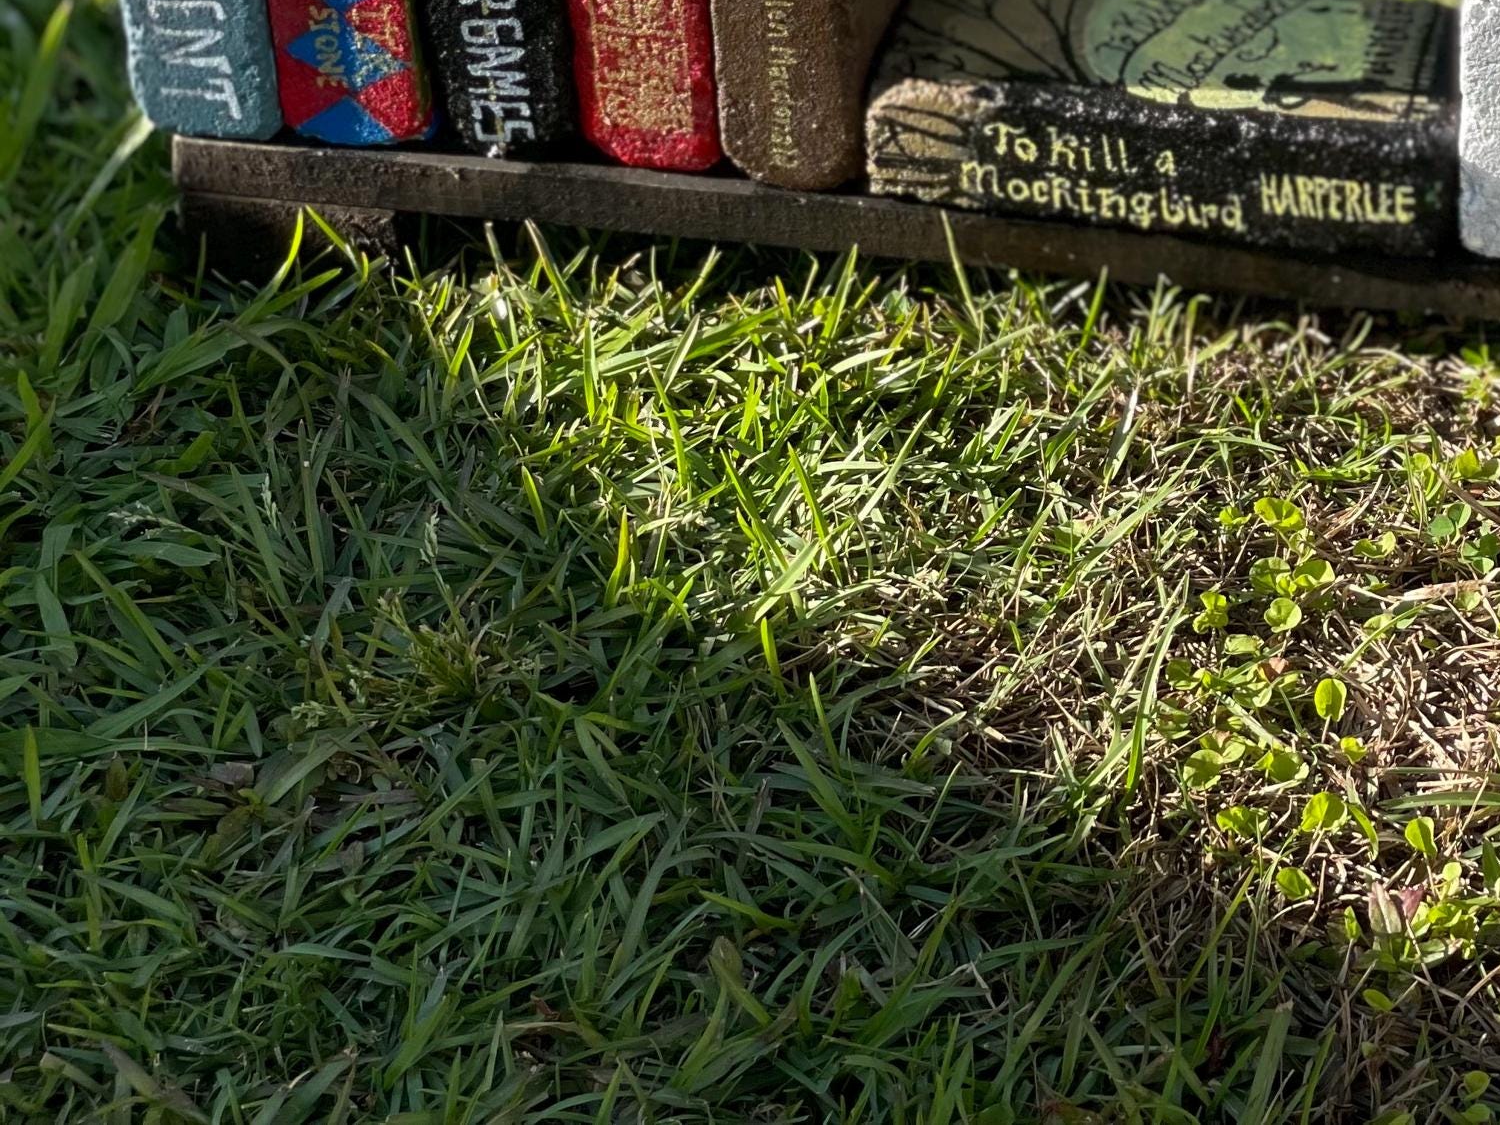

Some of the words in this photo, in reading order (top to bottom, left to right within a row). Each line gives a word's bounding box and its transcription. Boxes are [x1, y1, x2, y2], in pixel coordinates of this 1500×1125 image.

[308, 3, 350, 91] STONE
[983, 122, 1039, 163] To
[1154, 149, 1179, 177] a
